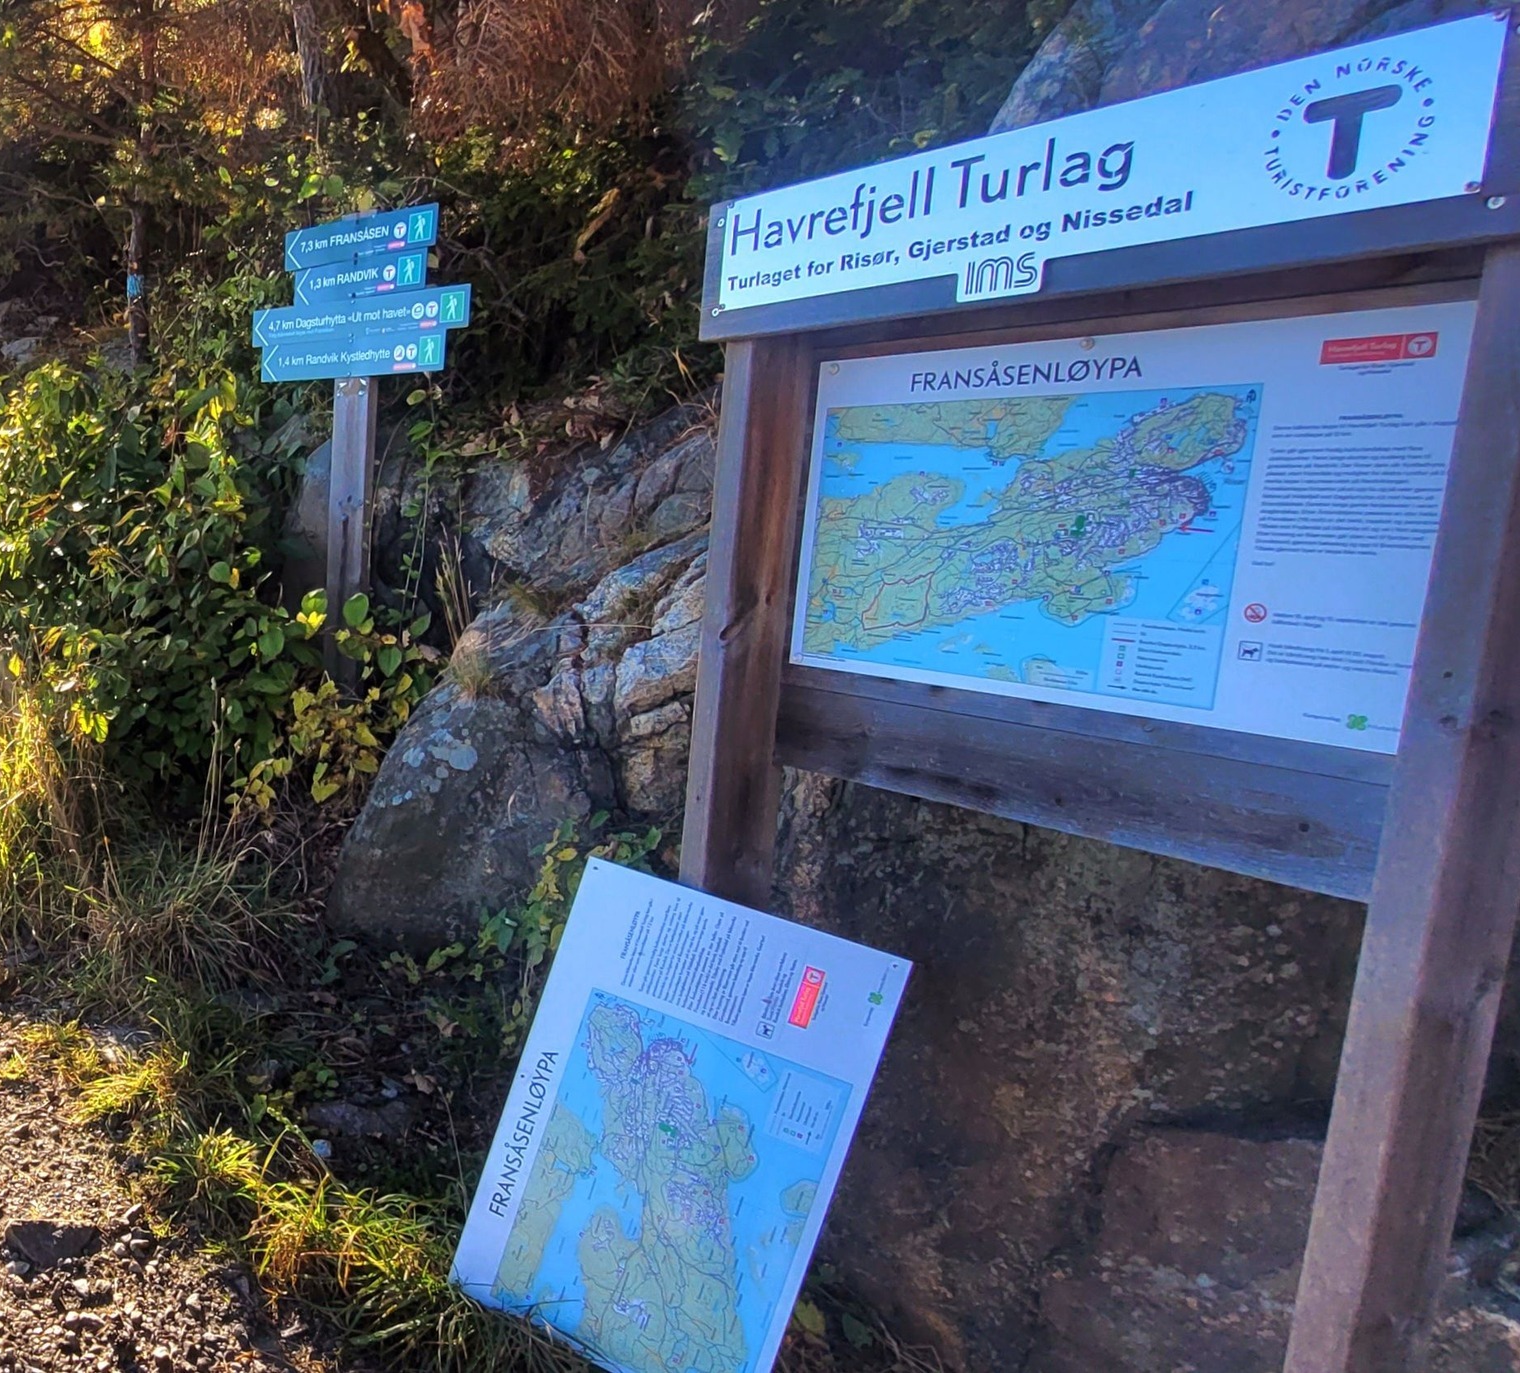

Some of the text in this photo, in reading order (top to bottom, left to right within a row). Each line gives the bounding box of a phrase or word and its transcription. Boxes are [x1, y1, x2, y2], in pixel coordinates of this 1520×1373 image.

[1276, 57, 1434, 122] DEN NORSKE
[1264, 115, 1435, 201] TURISTFORENING
[1303, 84, 1403, 180] T
[730, 137, 1135, 256] Havrefjell Turlag
[300, 240, 313, 253] 7,3
[314, 239, 328, 249] km
[330, 225, 389, 247] FRANSÅSEN
[728, 190, 1194, 292] Turlaget for Risør, Gjerstad og Nissedal
[309, 267, 380, 291] 1,3 km RANDVIK
[268, 320, 280, 332] 4,7
[282, 319, 294, 330] km
[296, 314, 346, 330] Dagsturhytta
[363, 308, 381, 321] mot
[291, 355, 304, 366] km
[306, 352, 339, 365] Randvik
[340, 348, 390, 364] Kystledhytte
[910, 355, 1143, 393] FRANSÅSENLØYPA
[489, 1051, 559, 1218] FRANSÅSENLØYPA
